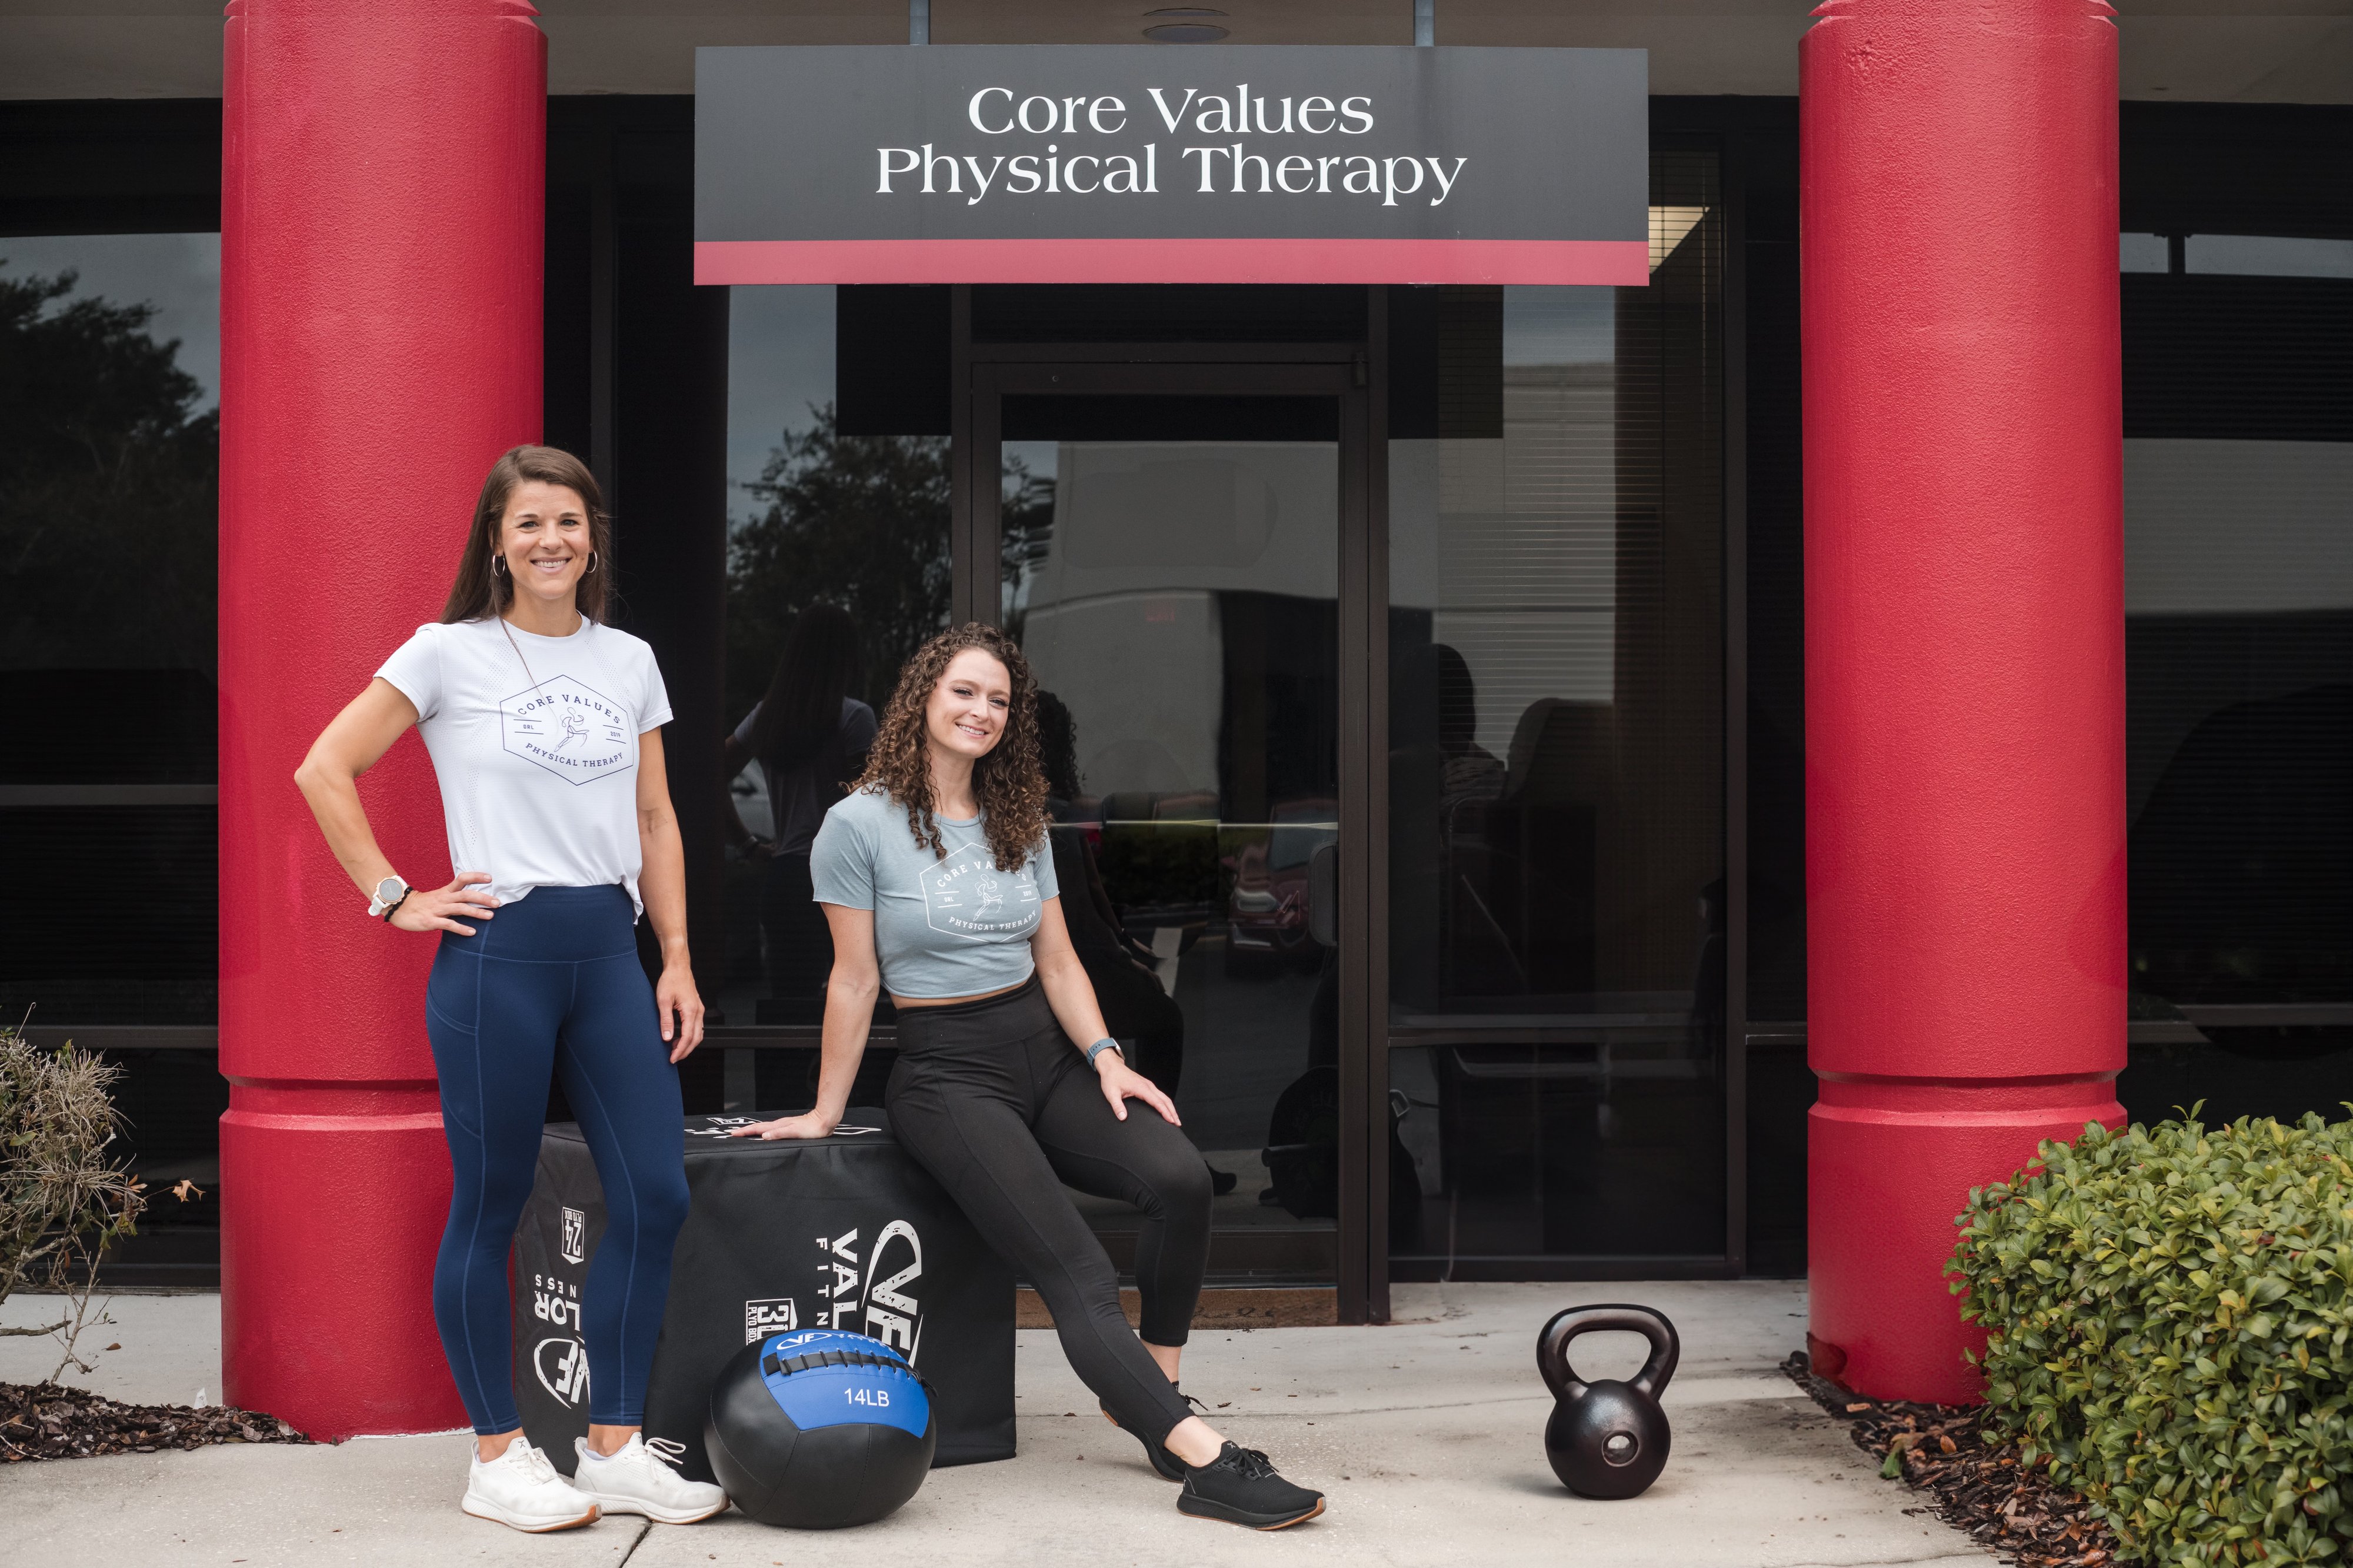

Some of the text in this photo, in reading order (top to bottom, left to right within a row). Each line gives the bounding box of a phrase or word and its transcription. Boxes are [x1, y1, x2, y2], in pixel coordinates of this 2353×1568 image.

[969, 84, 1373, 134] Core Values
[876, 144, 1467, 206] Physical Therapy
[518, 694, 621, 724] CORE VALUES
[525, 742, 623, 767] PHYSICAL THERAPY
[936, 864, 968, 888] CORE
[948, 910, 1036, 930] PHYSICAL THERAPY
[565, 1220, 581, 1256] 24
[534, 1274, 576, 1298] NESS
[816, 1237, 829, 1326] FITN
[832, 1227, 858, 1330] VAL
[534, 1291, 581, 1331] LOR
[748, 1307, 757, 1344] PLYO BOX
[844, 1388, 889, 1407] 14LB
